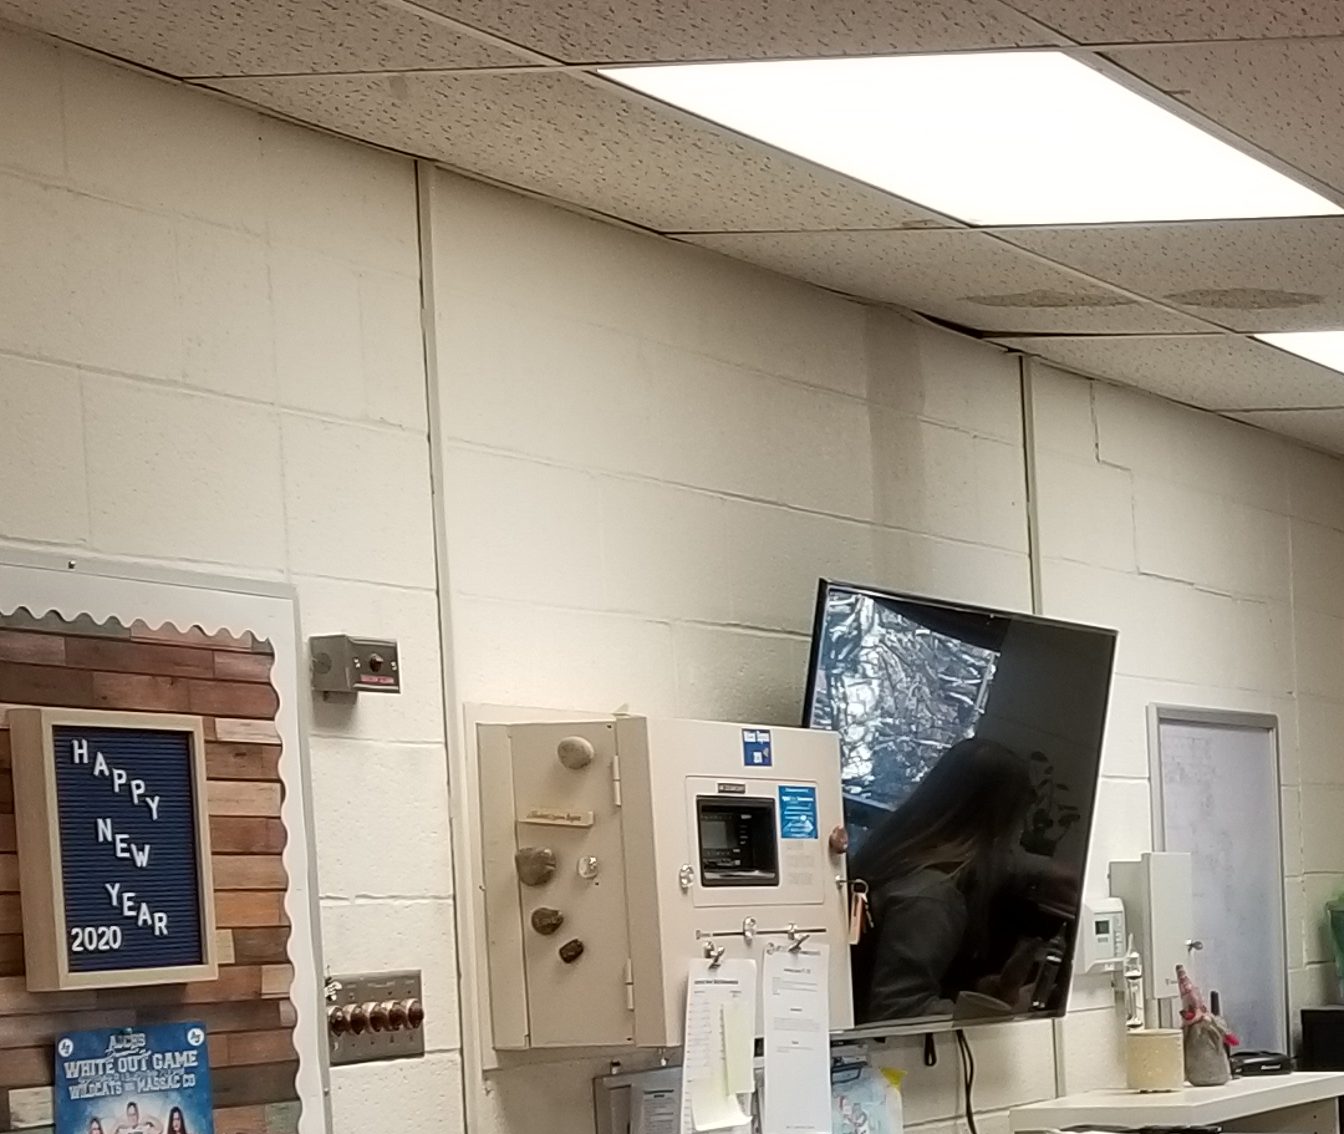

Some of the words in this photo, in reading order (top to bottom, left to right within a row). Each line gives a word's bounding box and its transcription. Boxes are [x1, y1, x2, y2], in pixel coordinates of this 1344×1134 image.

[70, 739, 160, 821] HAPPY
[96, 818, 150, 869] NEW
[105, 882, 169, 937] YEAR
[71, 925, 122, 951] 2020
[64, 1057, 115, 1078] WHITE
[118, 1055, 150, 1073] OUT
[152, 1050, 198, 1070] GAME
[69, 1080, 122, 1100] WILDCATS
